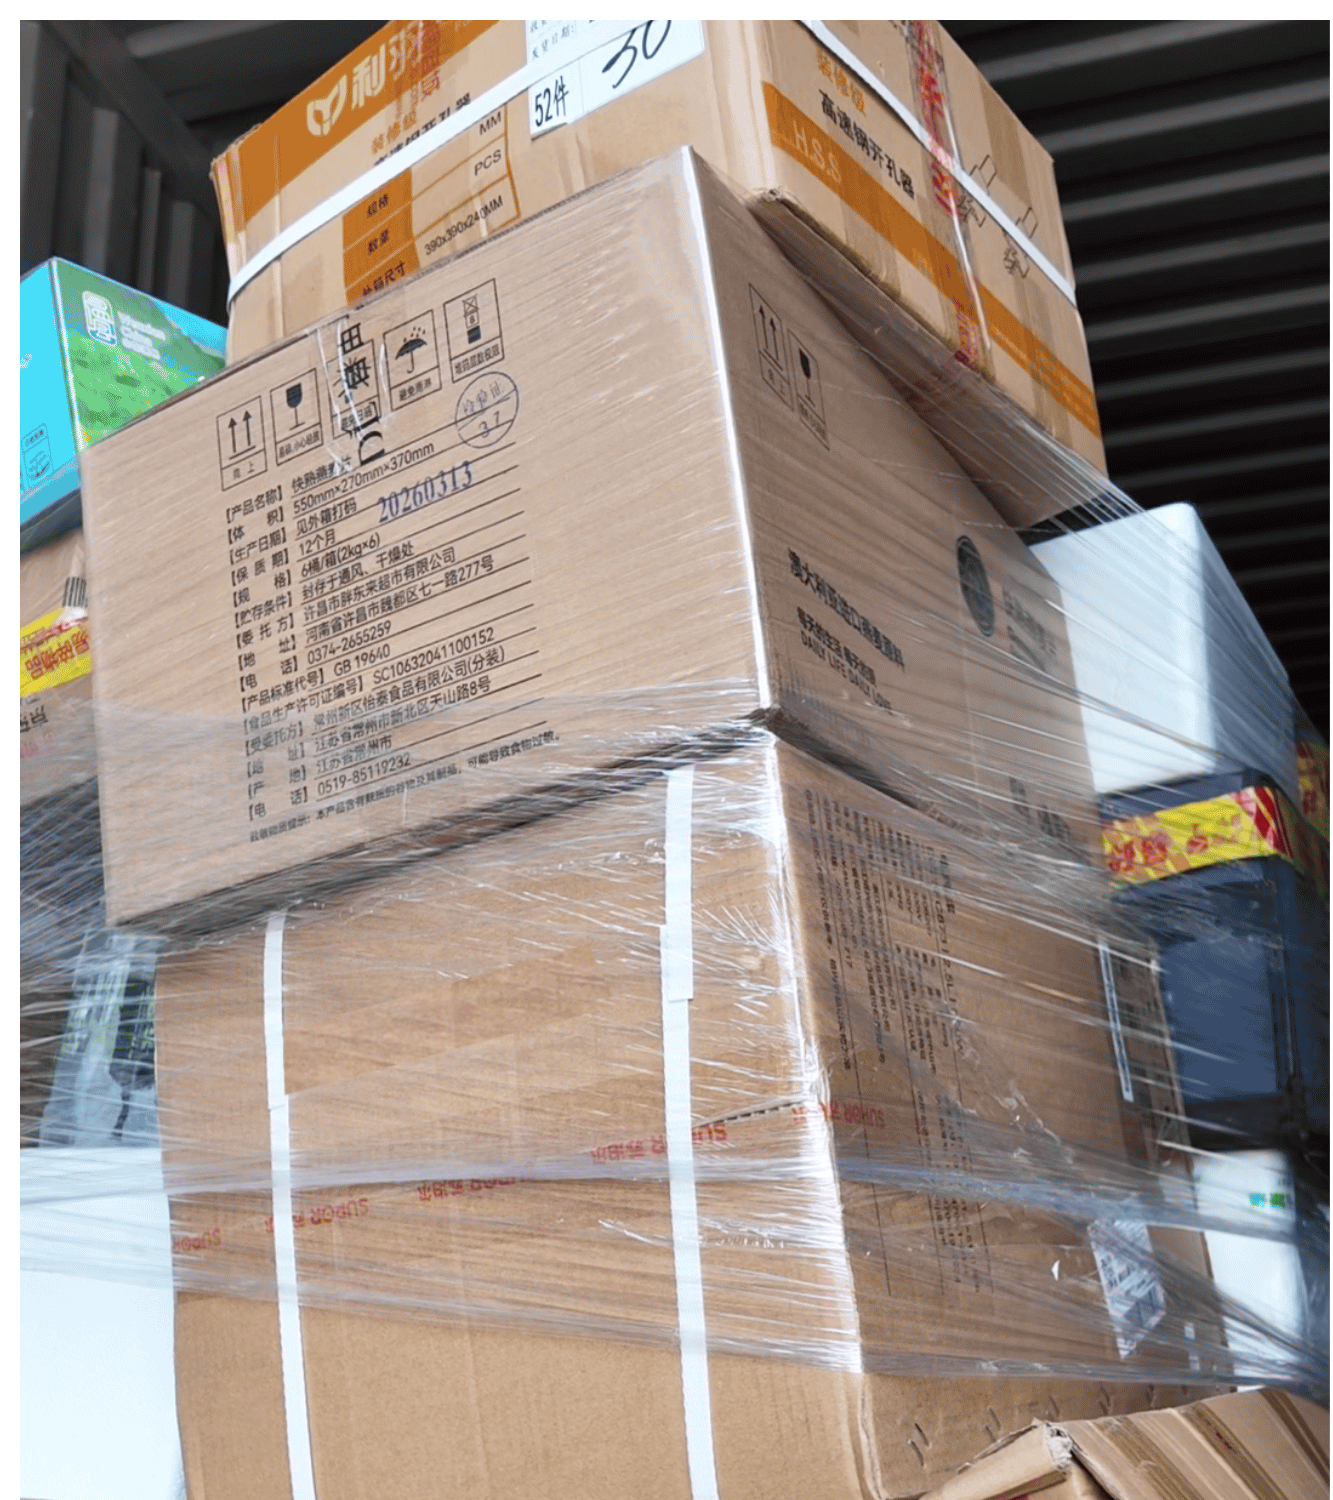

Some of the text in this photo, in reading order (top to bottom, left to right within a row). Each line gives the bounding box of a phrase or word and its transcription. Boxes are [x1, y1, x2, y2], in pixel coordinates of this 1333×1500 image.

[535, 74, 570, 129] 52件
[473, 150, 502, 177] PCS
[818, 88, 916, 200] 高速钢开孔器
[377, 460, 475, 525] 20260313
[296, 497, 358, 535] 见外箱打码
[299, 528, 337, 556] 12个月
[303, 547, 456, 622] 许昌市胖东来超市有限公司
[305, 554, 495, 644] 河南省许昌市魏都区七一路277号
[306, 620, 393, 666] 0374-2655259
[333, 655, 353, 676] GB
[354, 643, 391, 670] 19640
[373, 626, 495, 686] SC10632041100152
[317, 752, 412, 796] 0519-85119232
[309, 1196, 369, 1228] SUPOR
